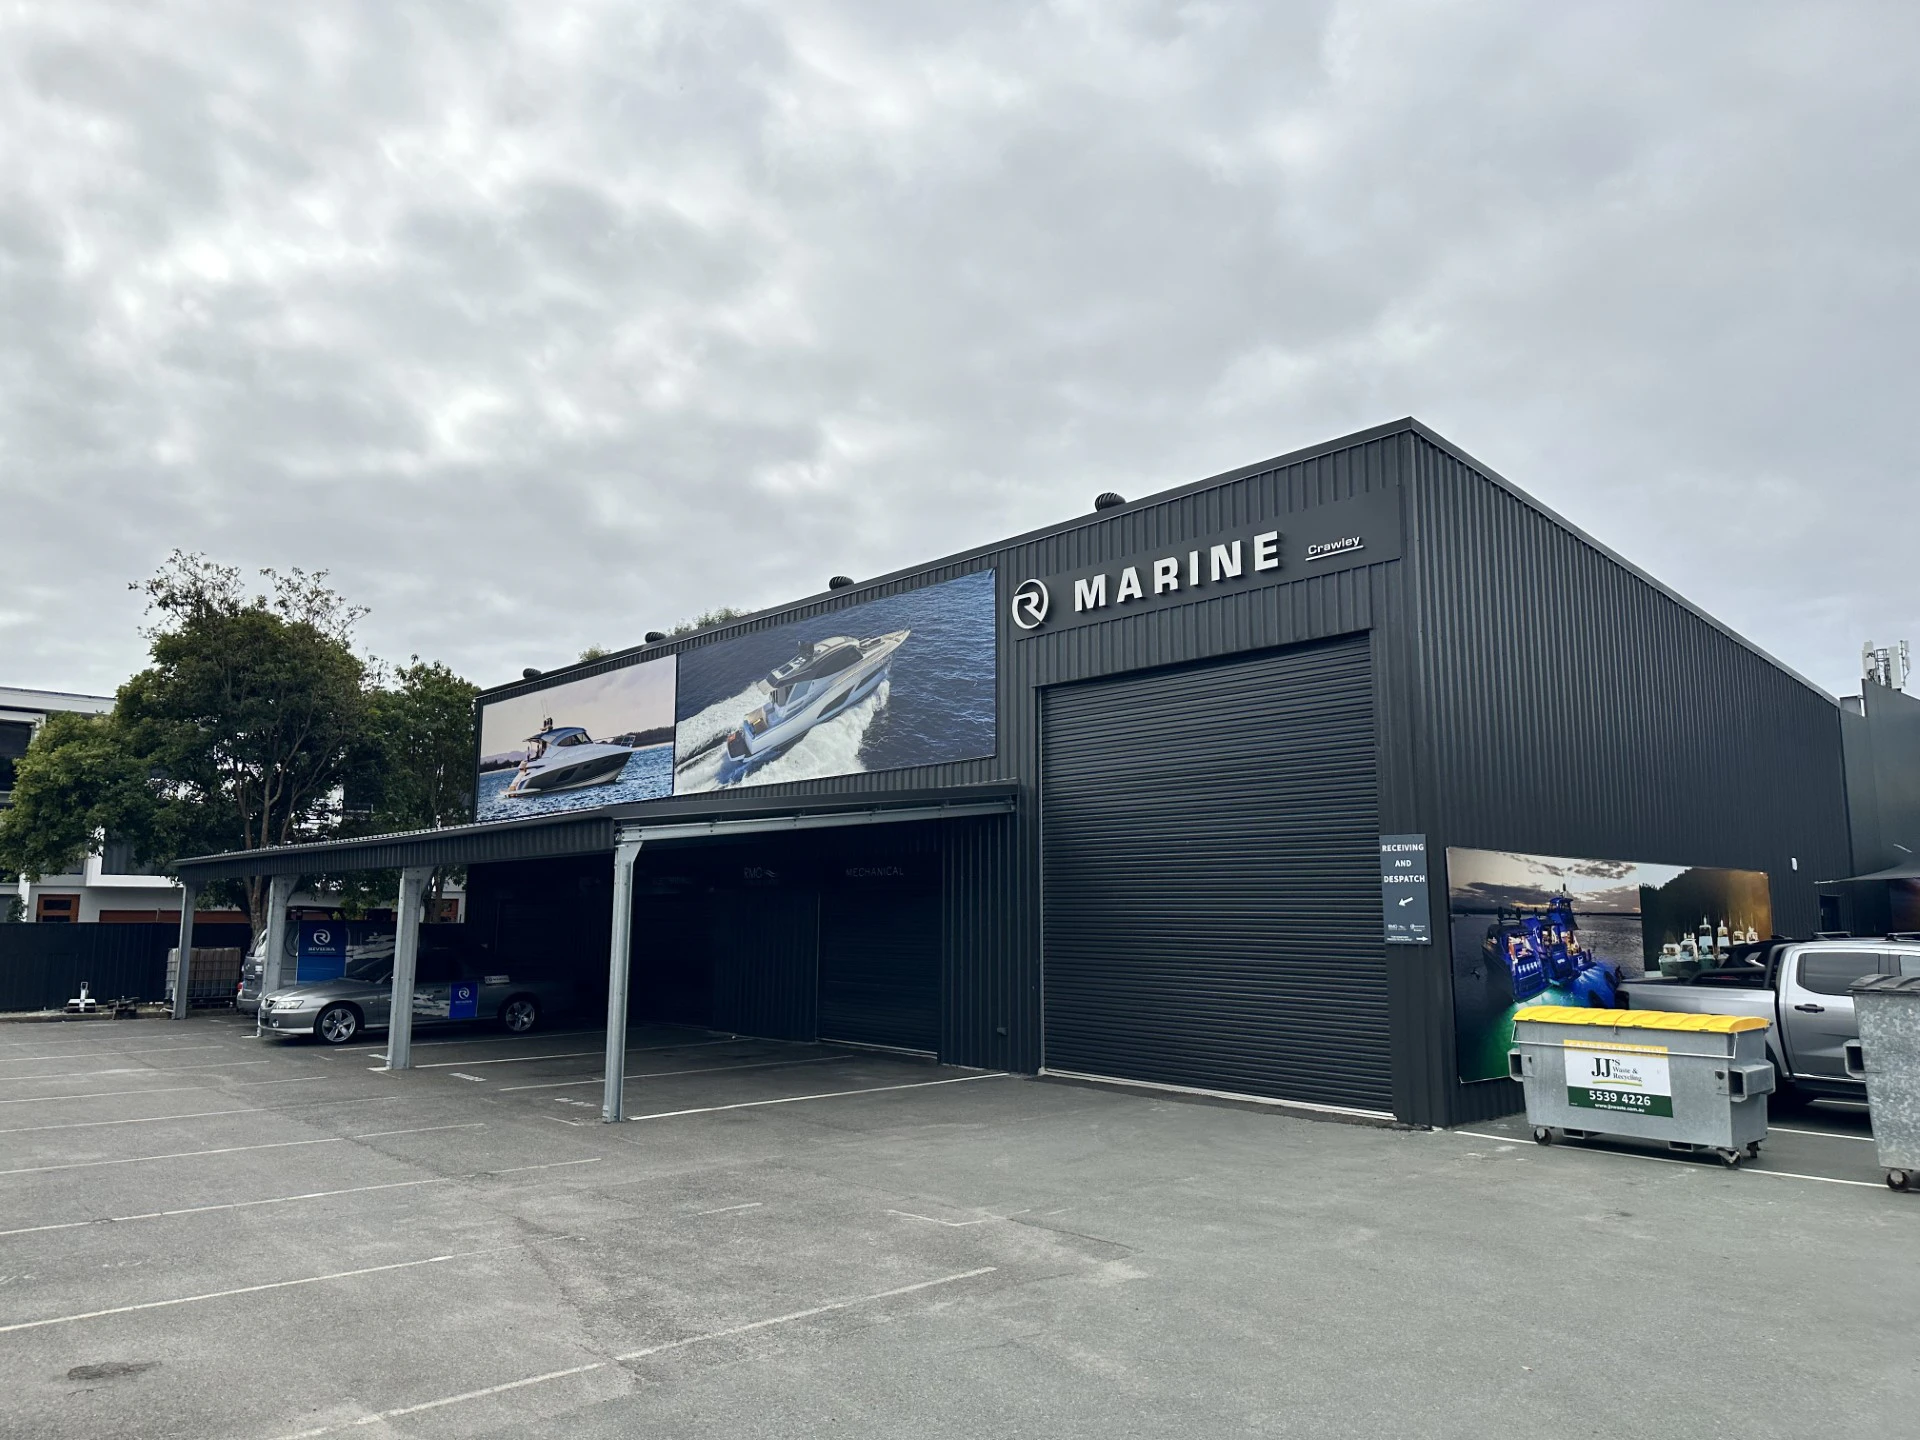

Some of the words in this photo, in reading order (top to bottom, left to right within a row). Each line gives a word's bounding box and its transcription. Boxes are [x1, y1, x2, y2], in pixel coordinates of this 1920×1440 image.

[1074, 530, 1279, 613] MARINE
[1308, 536, 1360, 555] Crawley
[1381, 843, 1424, 852] RECEIVING
[1394, 859, 1412, 867] AND
[845, 865, 904, 877] MECHANICAL
[1383, 875, 1426, 883] DESPATCH
[1612, 1066, 1630, 1074] Waste
[1613, 1073, 1643, 1083] Recycling
[1589, 1089, 1617, 1102] 5539
[1621, 1093, 1651, 1106] 4226
